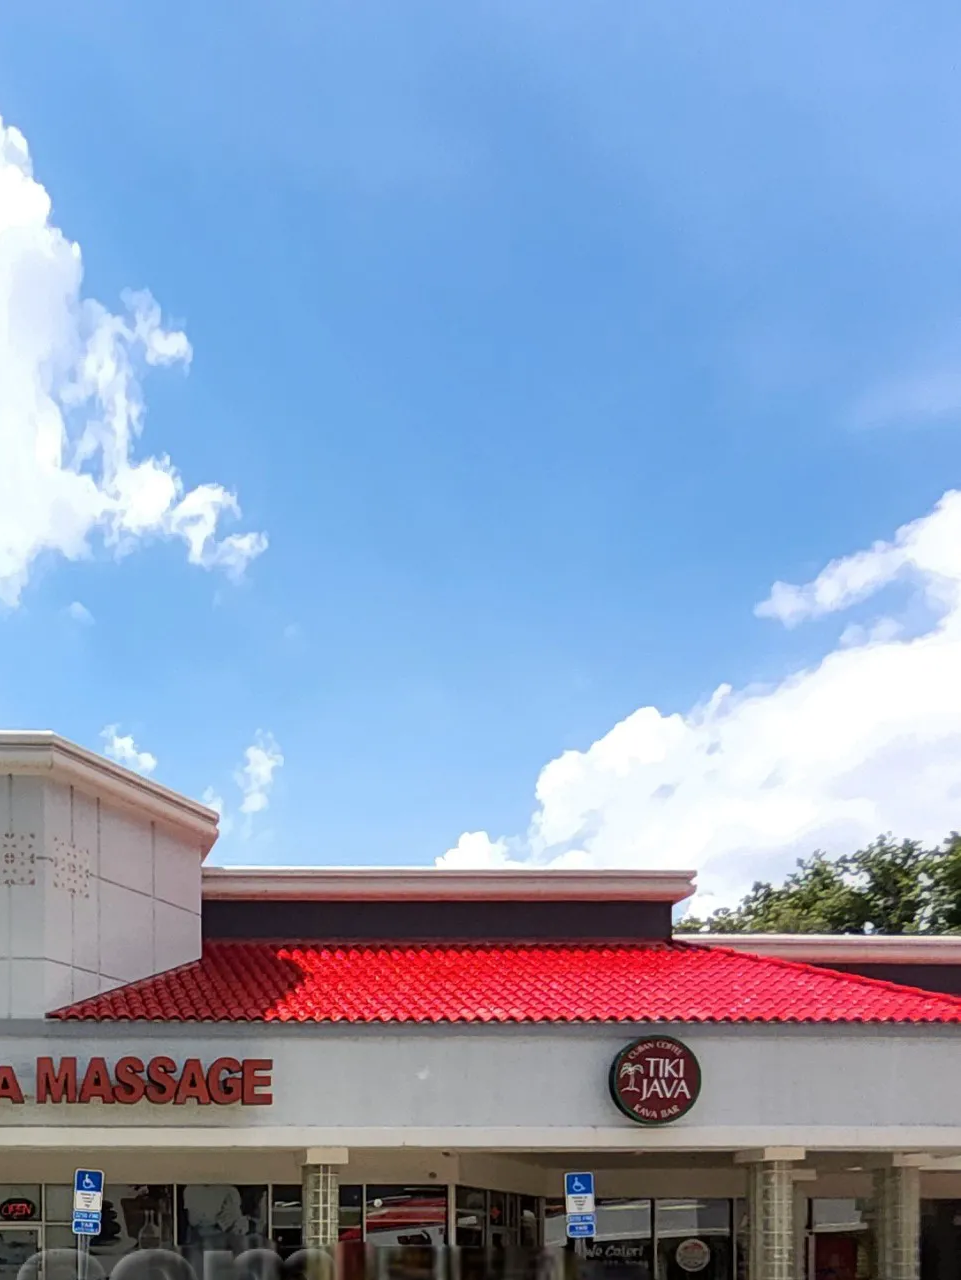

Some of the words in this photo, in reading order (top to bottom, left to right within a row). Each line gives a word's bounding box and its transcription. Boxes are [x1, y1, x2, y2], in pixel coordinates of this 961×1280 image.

[645, 1057, 684, 1078] TIKI
[36, 1056, 273, 1105] MASSAGE
[639, 1078, 691, 1101] JAVA
[633, 1104, 657, 1118] KAVA
[660, 1105, 680, 1118] BAR
[1, 1203, 31, 1217] OPEN
